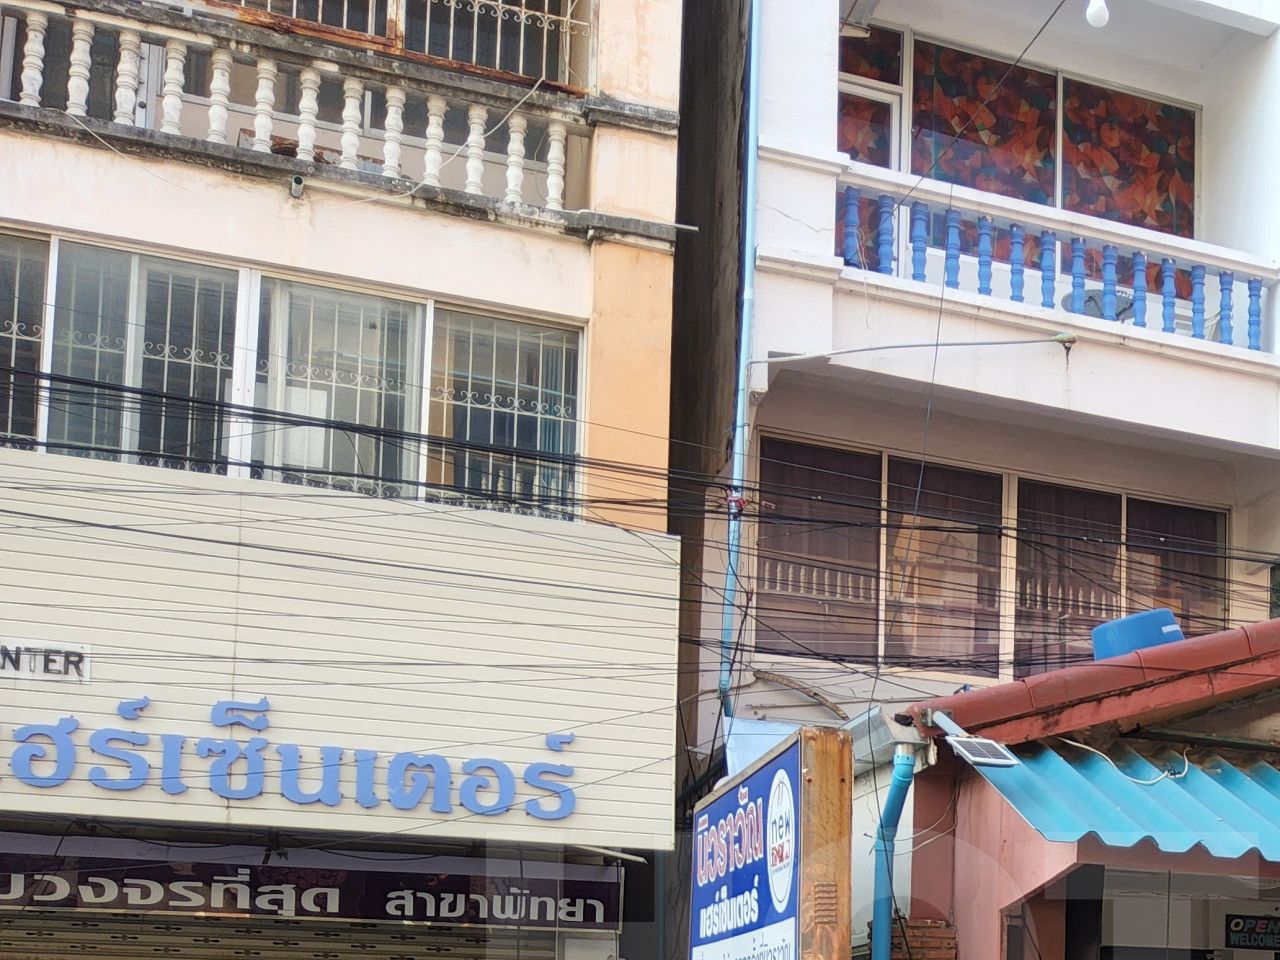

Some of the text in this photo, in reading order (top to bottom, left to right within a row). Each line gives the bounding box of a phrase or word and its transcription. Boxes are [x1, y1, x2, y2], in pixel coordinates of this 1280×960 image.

[0, 645, 84, 677] NTER
[1230, 918, 1280, 934] OPEN
[1230, 933, 1280, 948] WELCOME
